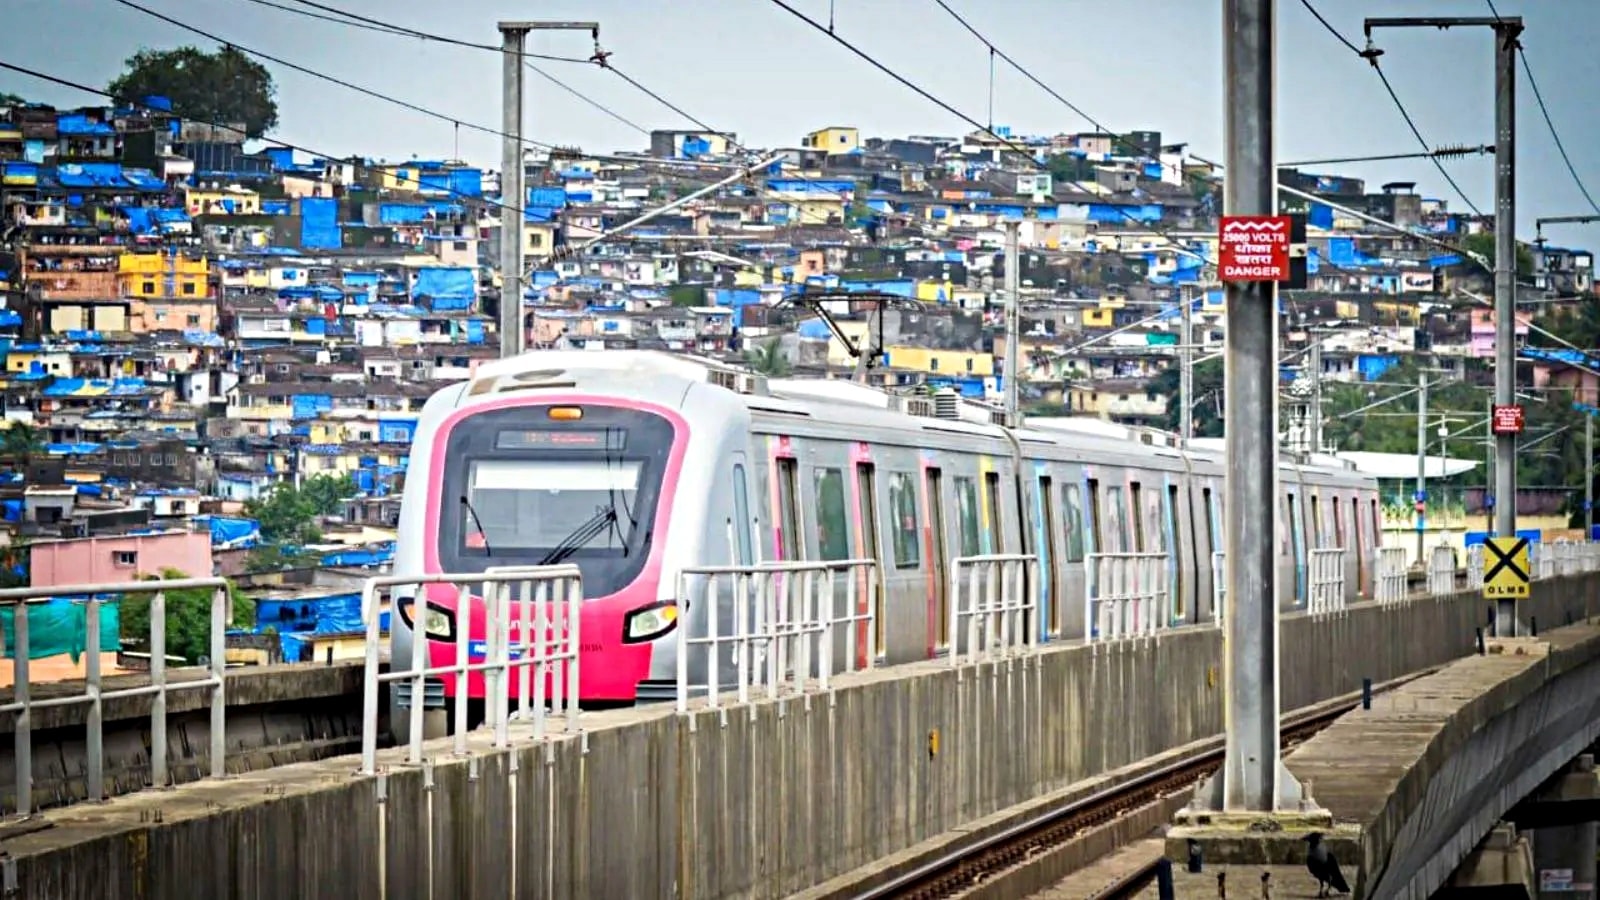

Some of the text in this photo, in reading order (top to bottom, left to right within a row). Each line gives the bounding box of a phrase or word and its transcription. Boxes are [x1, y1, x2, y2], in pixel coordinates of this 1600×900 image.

[1223, 232, 1285, 243] 25000 VOLTS
[1225, 266, 1281, 276] DANGER
